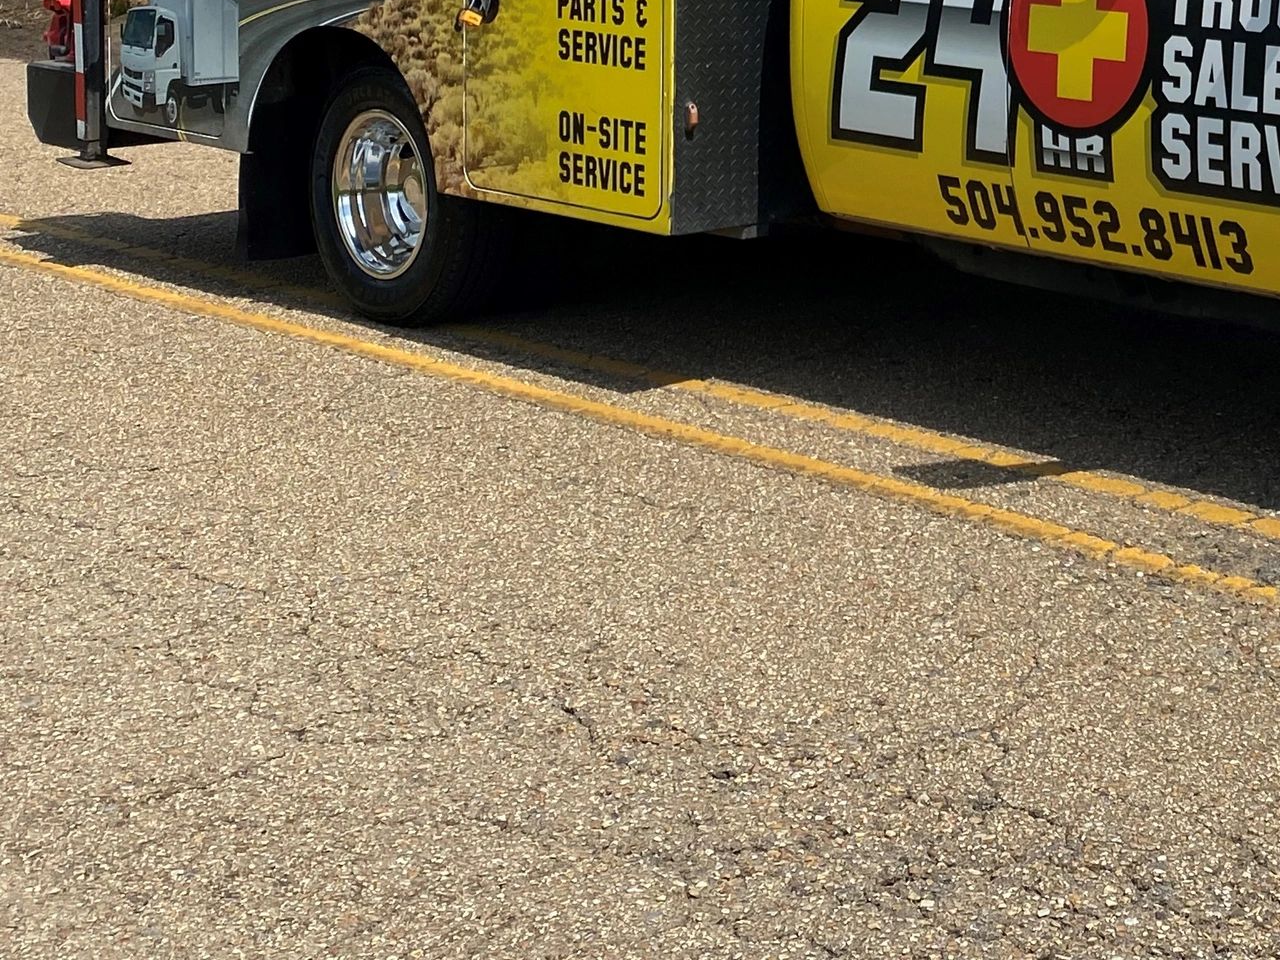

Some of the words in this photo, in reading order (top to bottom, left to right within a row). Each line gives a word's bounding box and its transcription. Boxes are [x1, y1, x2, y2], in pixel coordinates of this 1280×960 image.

[558, 29, 646, 70] SERVICE
[559, 110, 647, 155] ON-SITE
[1041, 124, 1105, 174] HR
[558, 152, 645, 197] SERVICE
[936, 174, 1254, 275] 504.952.8413
